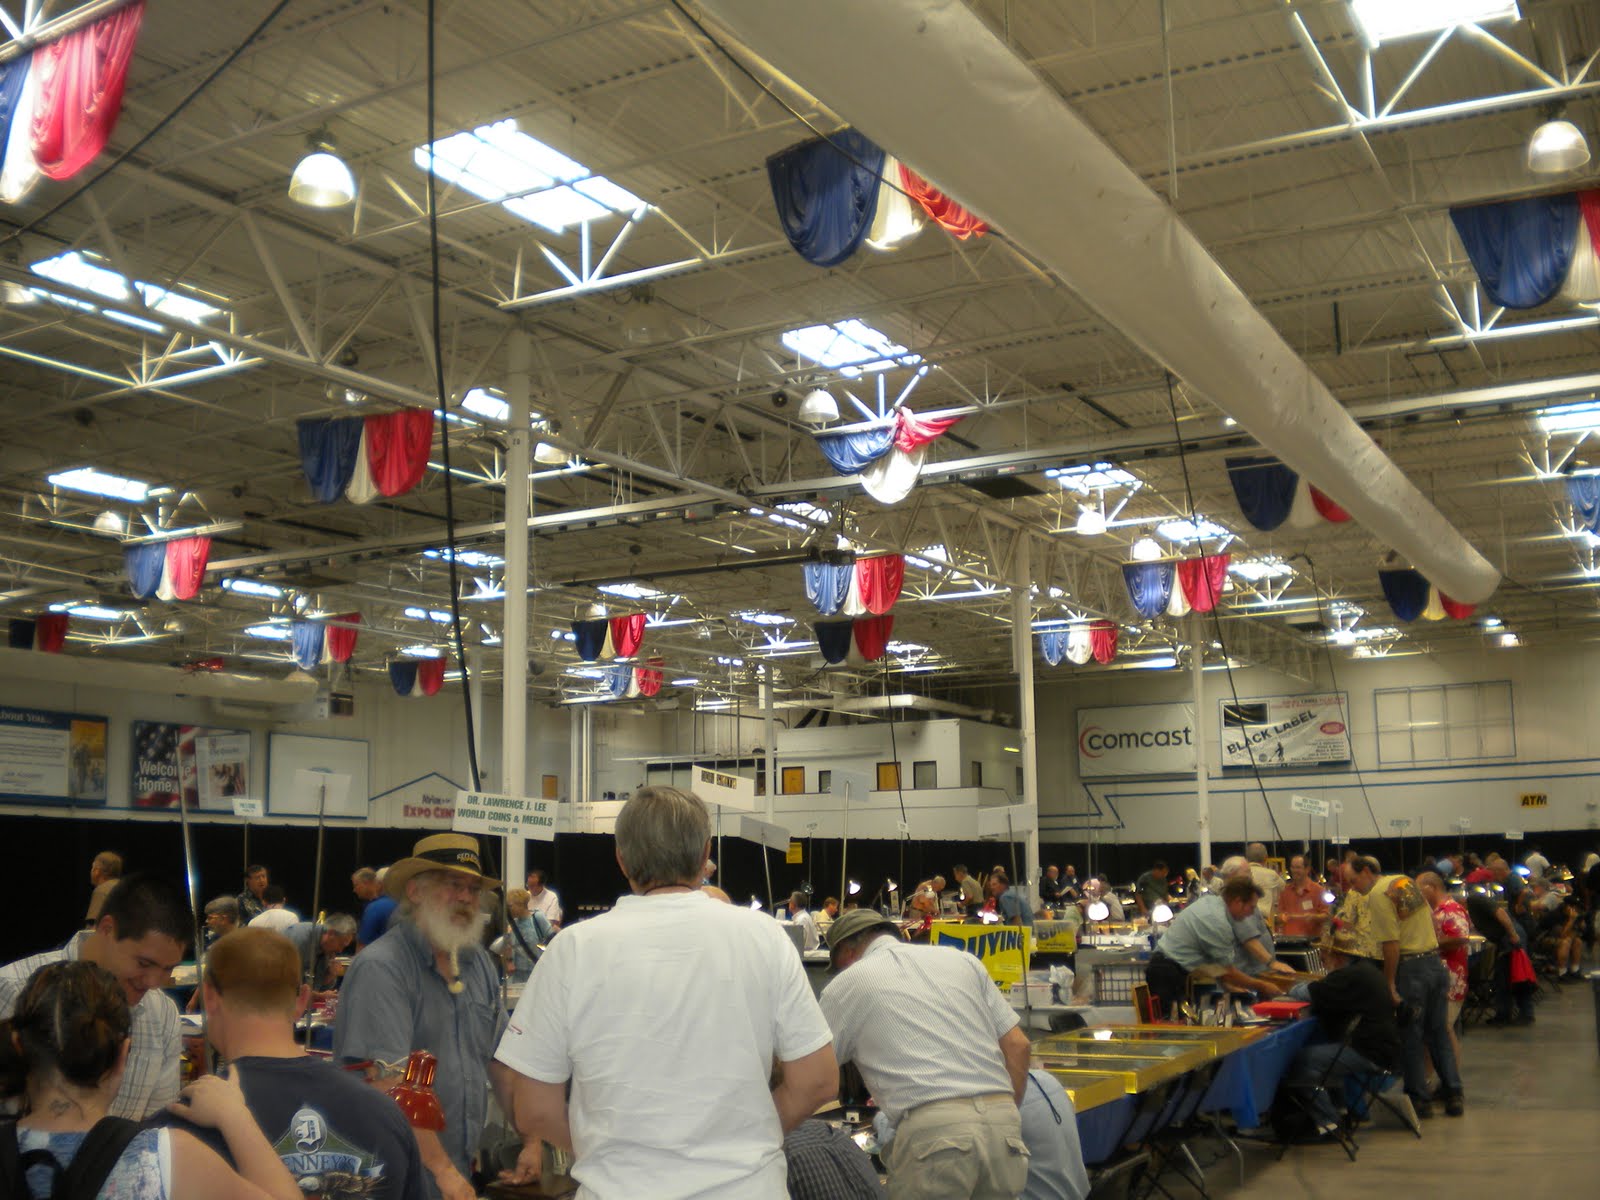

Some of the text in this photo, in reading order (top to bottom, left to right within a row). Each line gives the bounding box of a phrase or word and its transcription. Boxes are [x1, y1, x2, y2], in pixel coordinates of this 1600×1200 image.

[1088, 726, 1192, 750] comcast
[1226, 729, 1272, 755] BLACK
[1273, 709, 1318, 735] LABEL
[467, 795, 547, 812] DR. LAWRENCE J. LEE
[1521, 795, 1548, 807] ATM
[403, 804, 431, 818] EXPO
[457, 808, 553, 827] WORLD COINS & MEDALS
[281, 1153, 355, 1175] ENNEY'S
